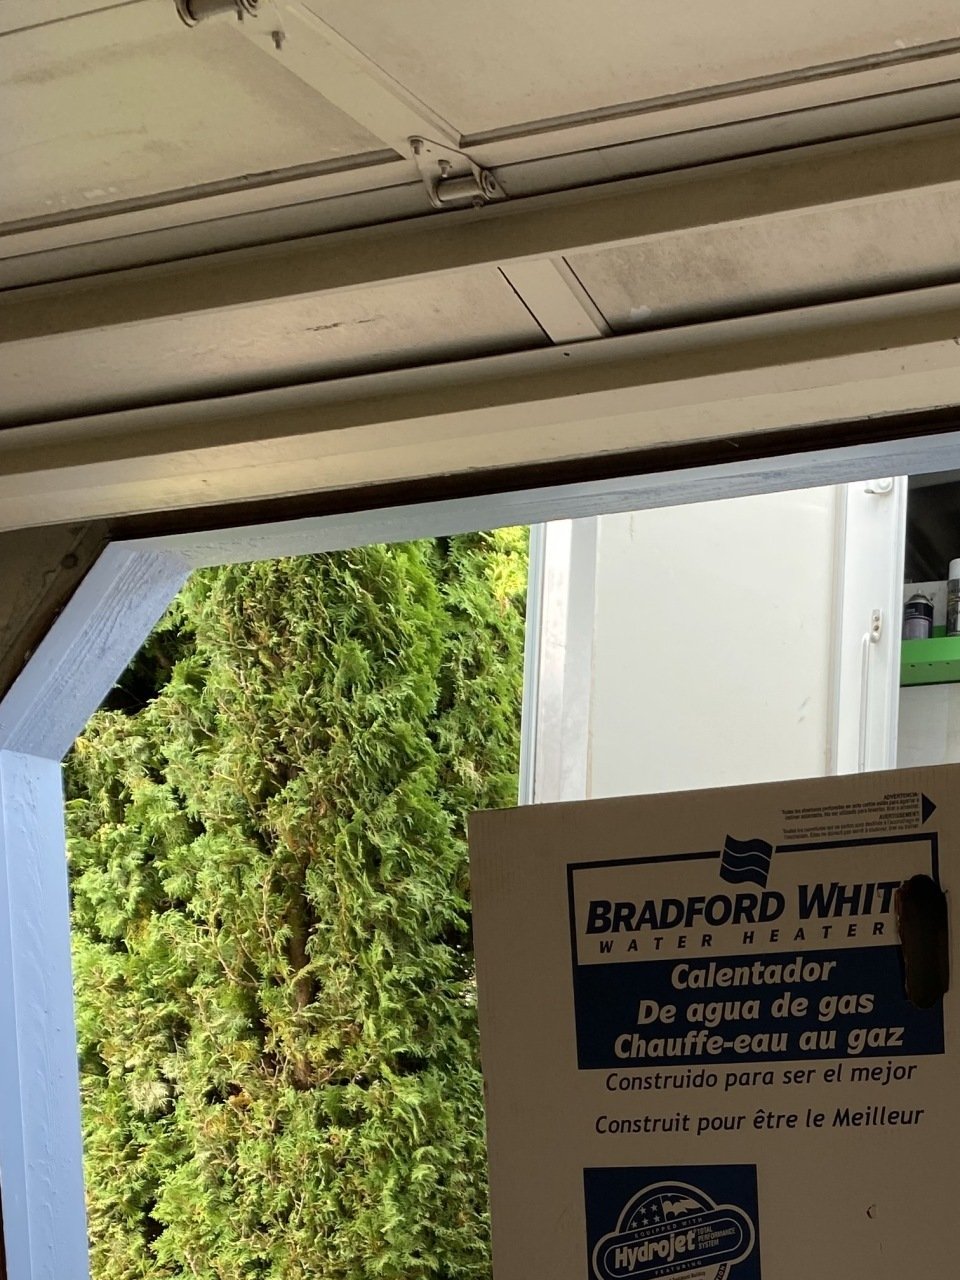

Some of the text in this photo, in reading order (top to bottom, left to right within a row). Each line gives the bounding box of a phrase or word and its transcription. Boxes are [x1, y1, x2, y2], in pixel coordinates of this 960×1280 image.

[585, 880, 905, 934] BRADFORD WHIT
[599, 933, 713, 953] WATER
[671, 956, 837, 990] Calentador
[637, 992, 875, 1028] De agua de gas
[614, 1027, 905, 1059] Chauffe-eau au gaz
[605, 1061, 918, 1092] Construido para ser el mejor
[595, 1106, 924, 1136] Construit pour être le Meilleur
[614, 1229, 696, 1272] Hydrojet
